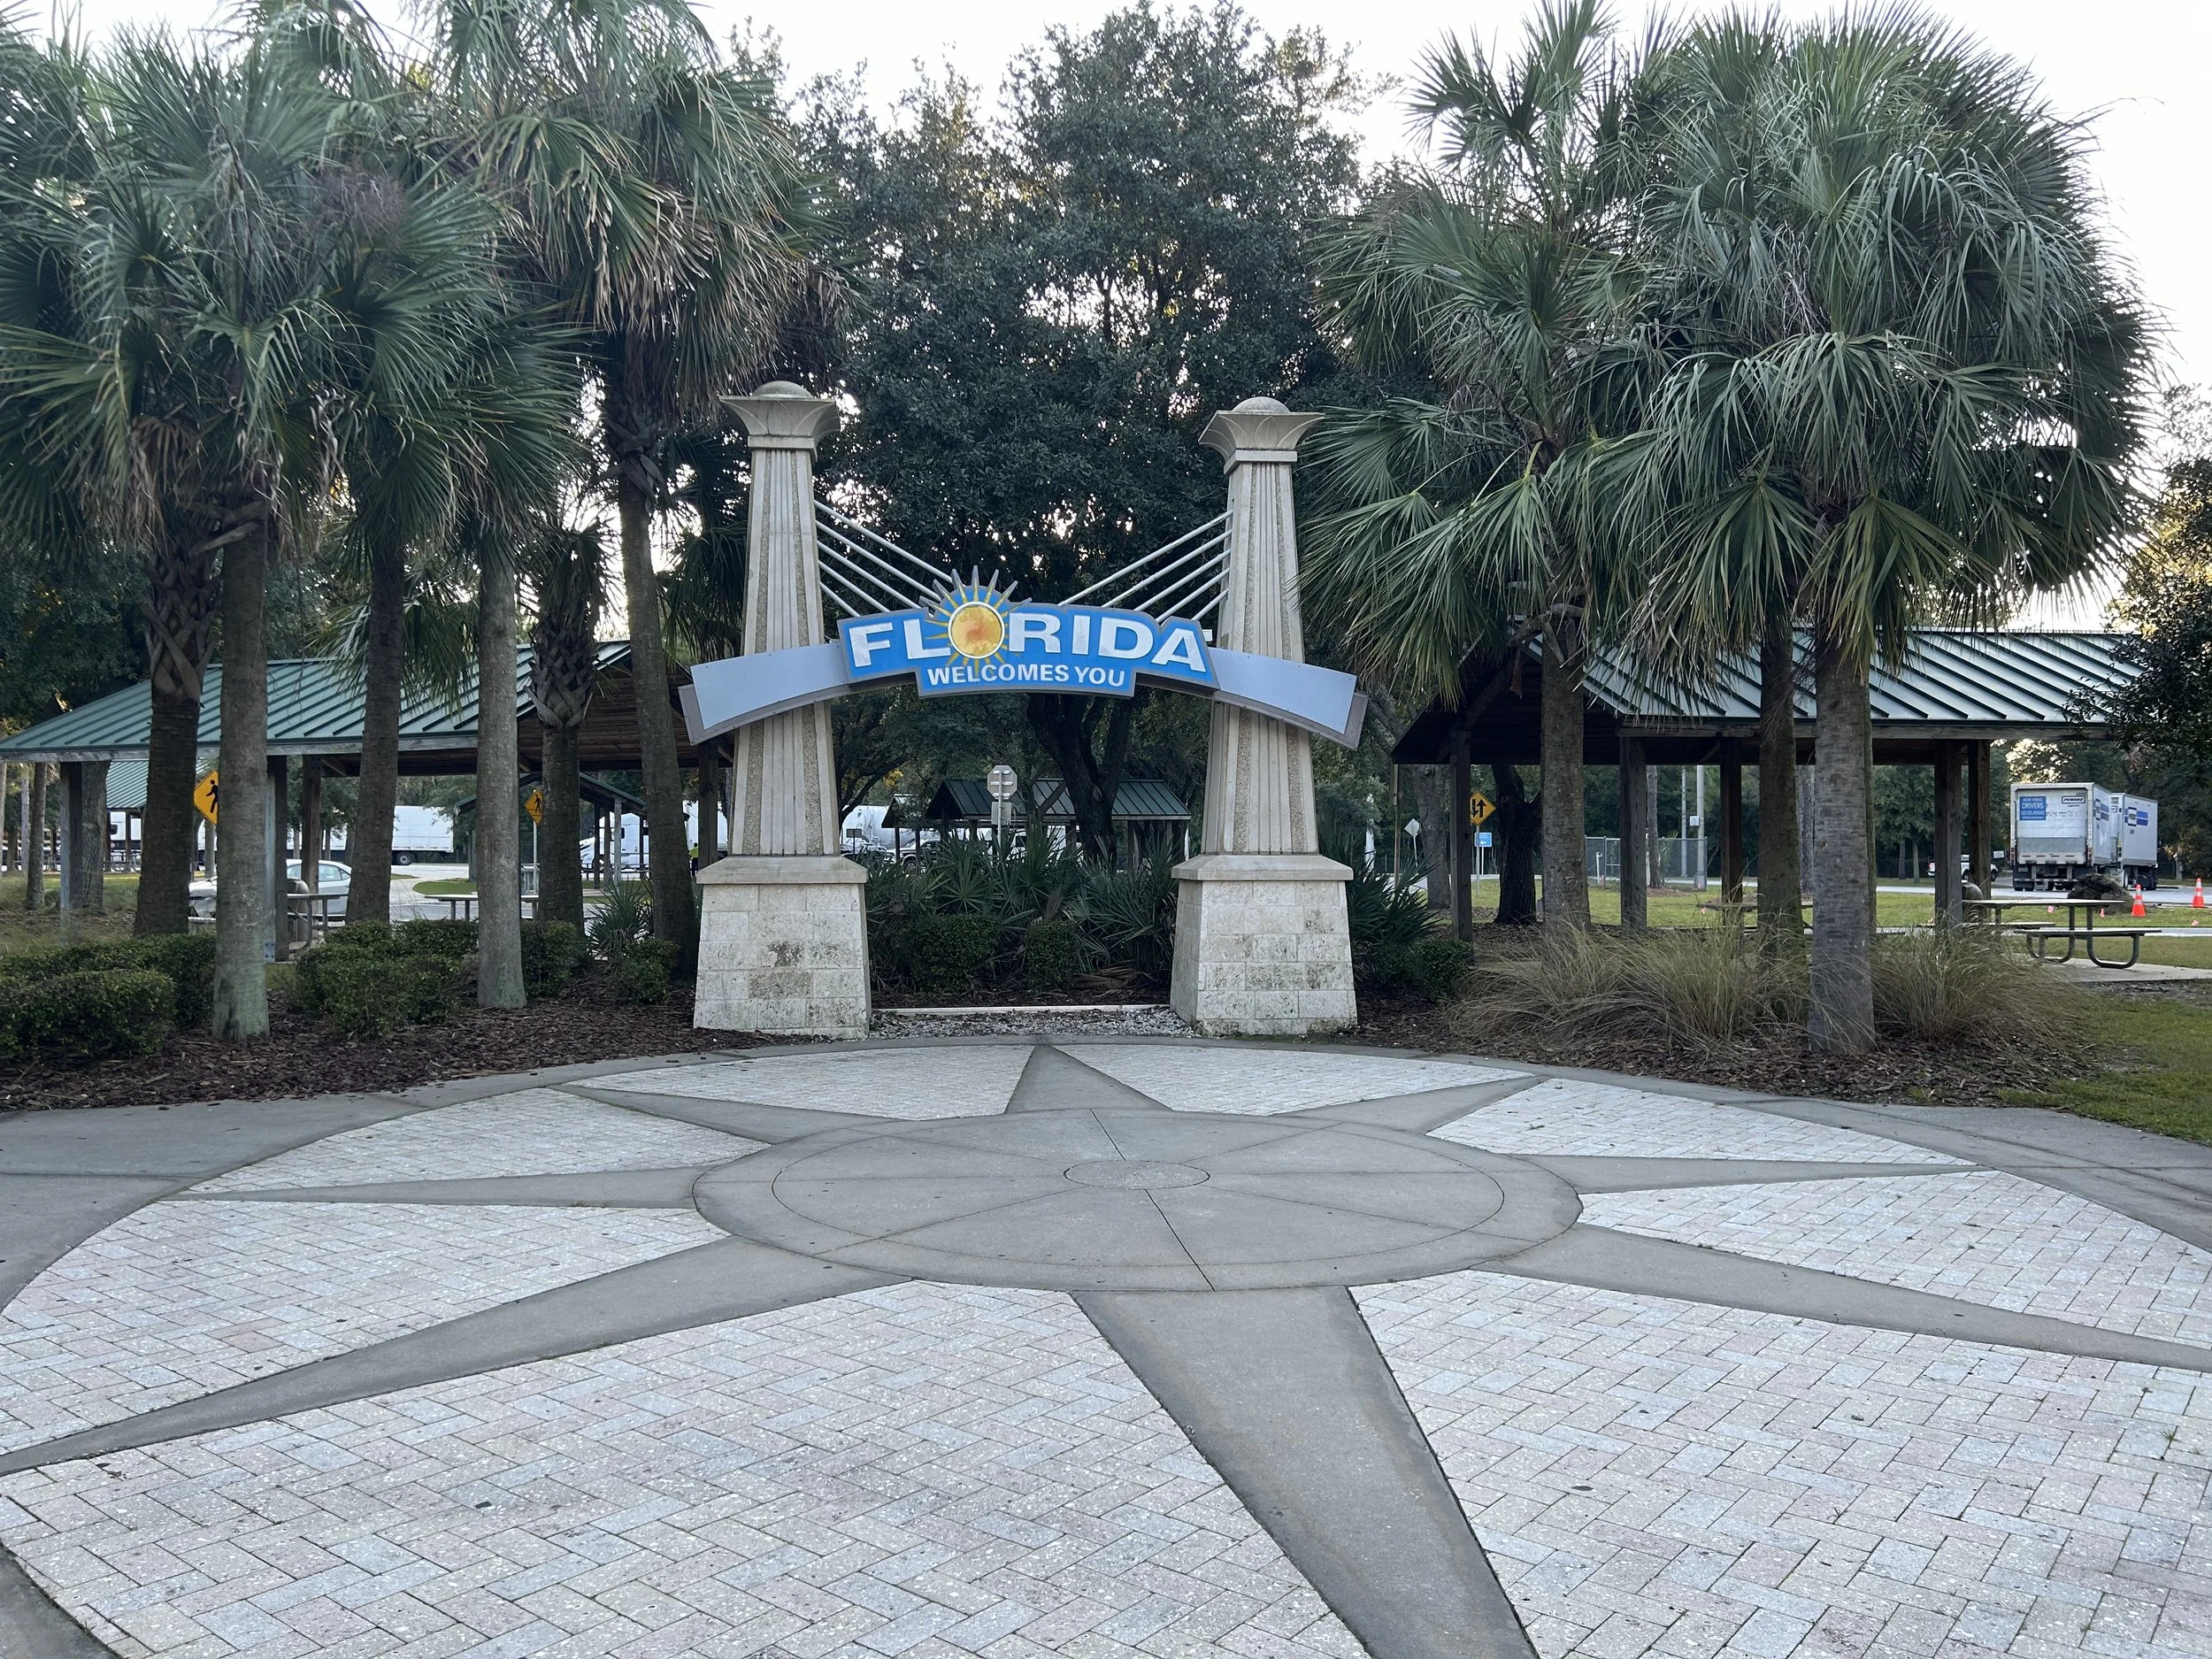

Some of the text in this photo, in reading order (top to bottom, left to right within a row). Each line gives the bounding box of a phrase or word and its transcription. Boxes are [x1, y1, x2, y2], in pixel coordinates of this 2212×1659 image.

[849, 601, 1206, 672] FLORIDA
[927, 664, 1125, 687] WELCOMES YOU
